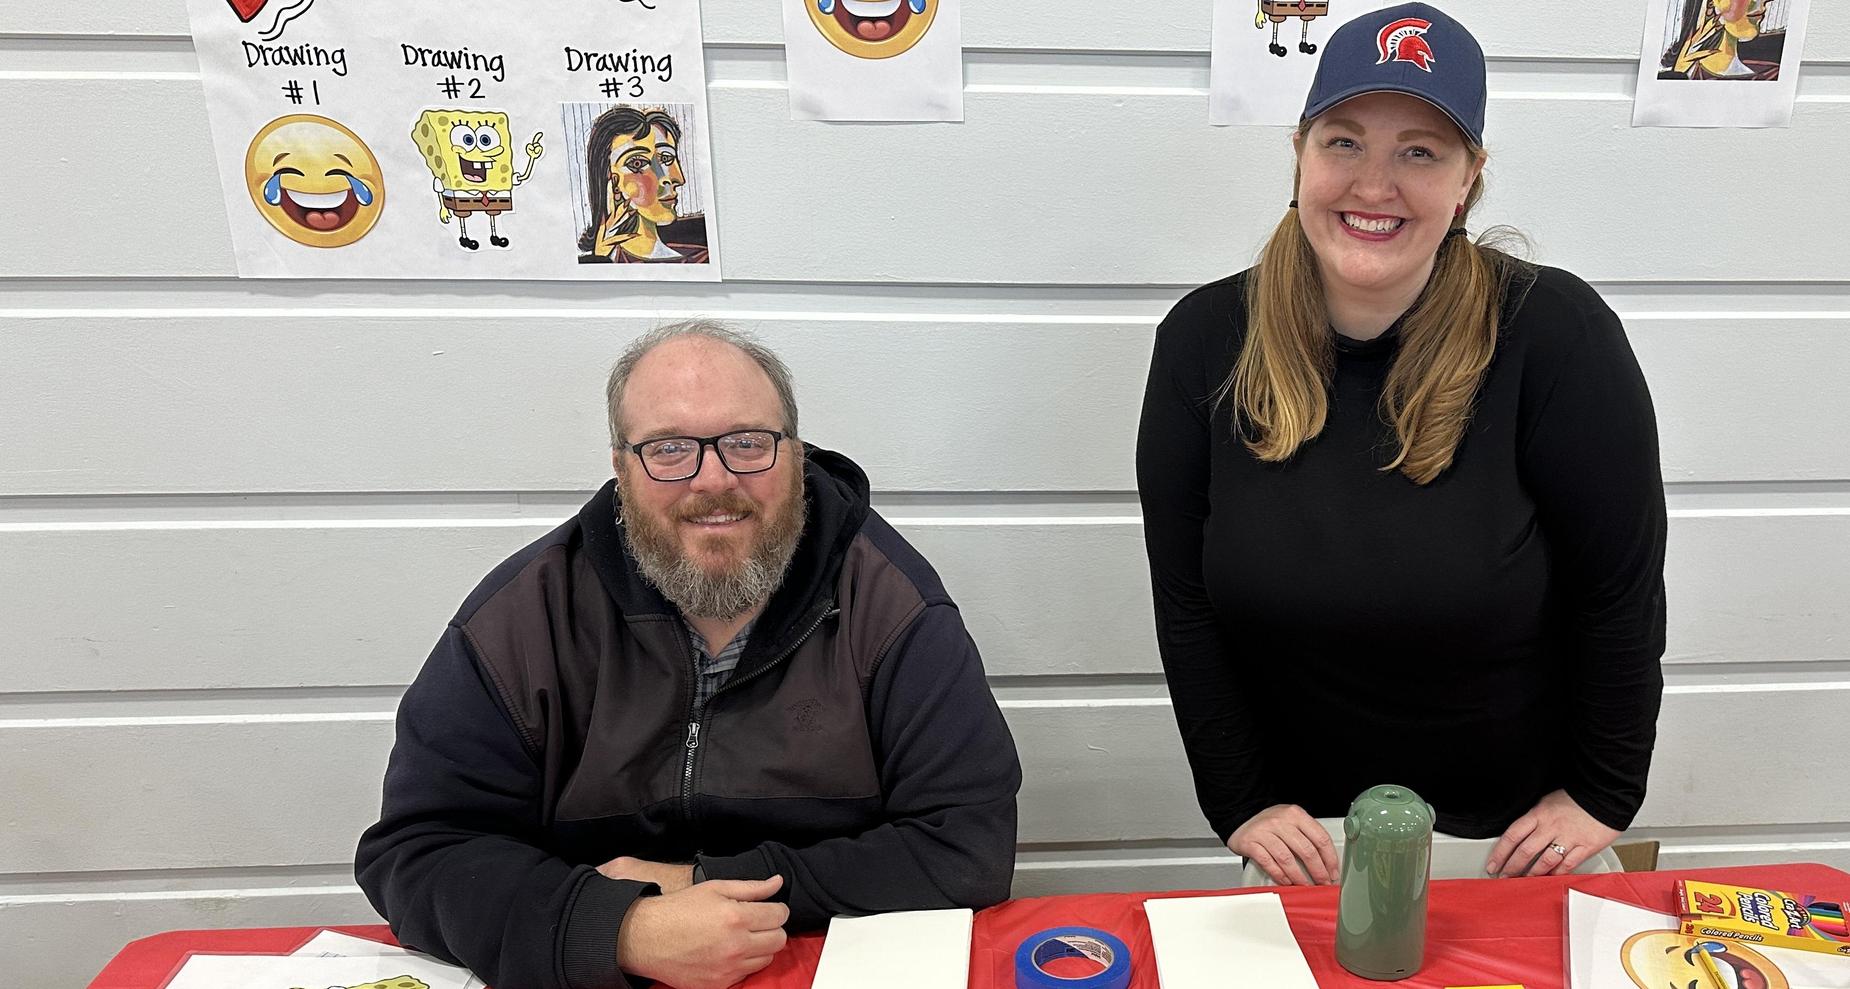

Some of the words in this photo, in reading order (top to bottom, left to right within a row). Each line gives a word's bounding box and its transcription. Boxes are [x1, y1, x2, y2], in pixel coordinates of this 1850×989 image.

[242, 41, 348, 77] Drawing
[401, 44, 505, 82] Drawing
[565, 47, 673, 82] Drawing
[282, 80, 319, 105] #1
[437, 75, 486, 99] #2
[599, 76, 644, 98] #3
[1694, 891, 1724, 914] 24
[1736, 891, 1760, 923] Pencils
[1753, 892, 1780, 931] Colored
[1700, 928, 1735, 939] Colored
[1733, 932, 1764, 942] Pencils
